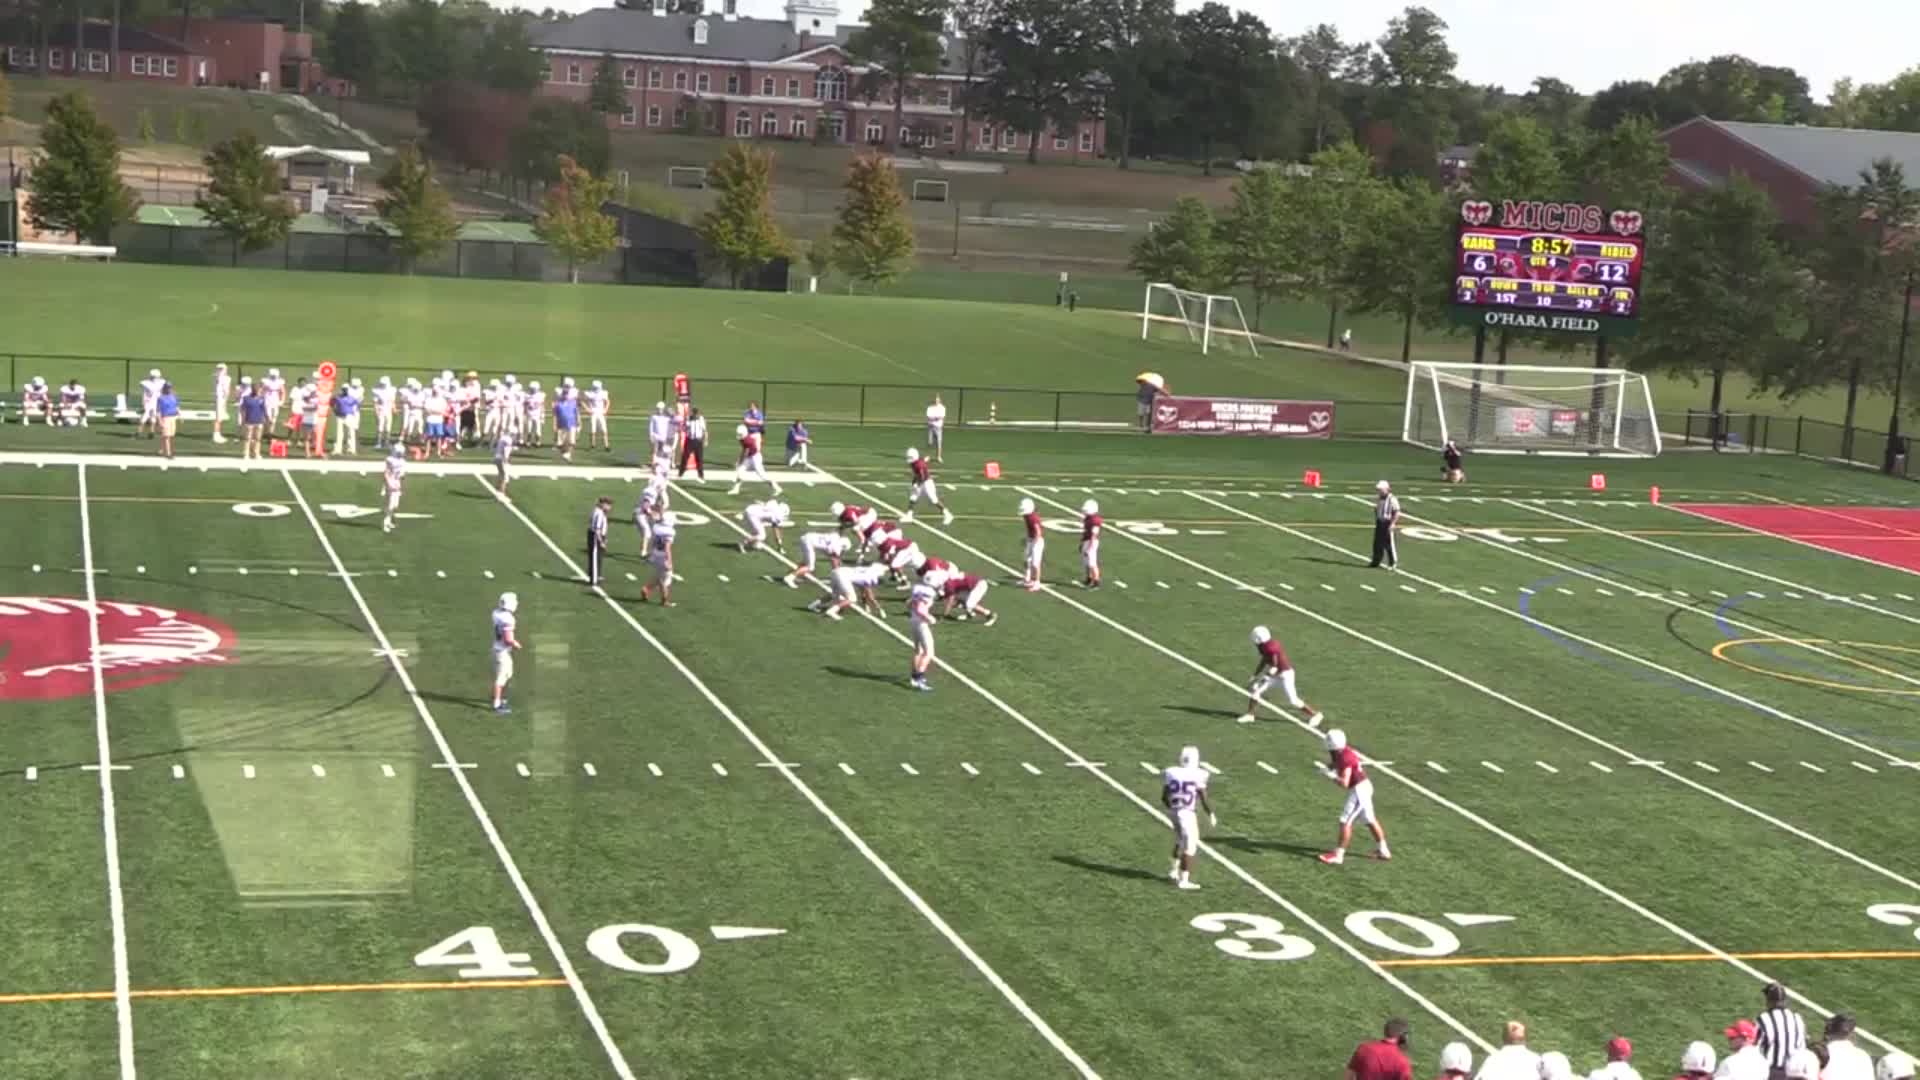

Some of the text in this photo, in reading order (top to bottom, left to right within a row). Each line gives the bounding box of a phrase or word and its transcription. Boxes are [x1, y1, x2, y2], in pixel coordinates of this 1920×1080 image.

[1501, 199, 1603, 233] MICDS
[1531, 238, 1574, 256] 8:57
[1474, 256, 1487, 271] 6
[1549, 257, 1556, 267] 4
[1600, 265, 1625, 281] 12
[1496, 292, 1518, 304] 1ST
[1537, 295, 1552, 307] 10
[1577, 298, 1594, 310] 29
[1485, 311, 1600, 332] O'HARA FIELD
[1168, 779, 1194, 807] 25
[1190, 911, 1461, 960] 30
[414, 926, 701, 978] 40
